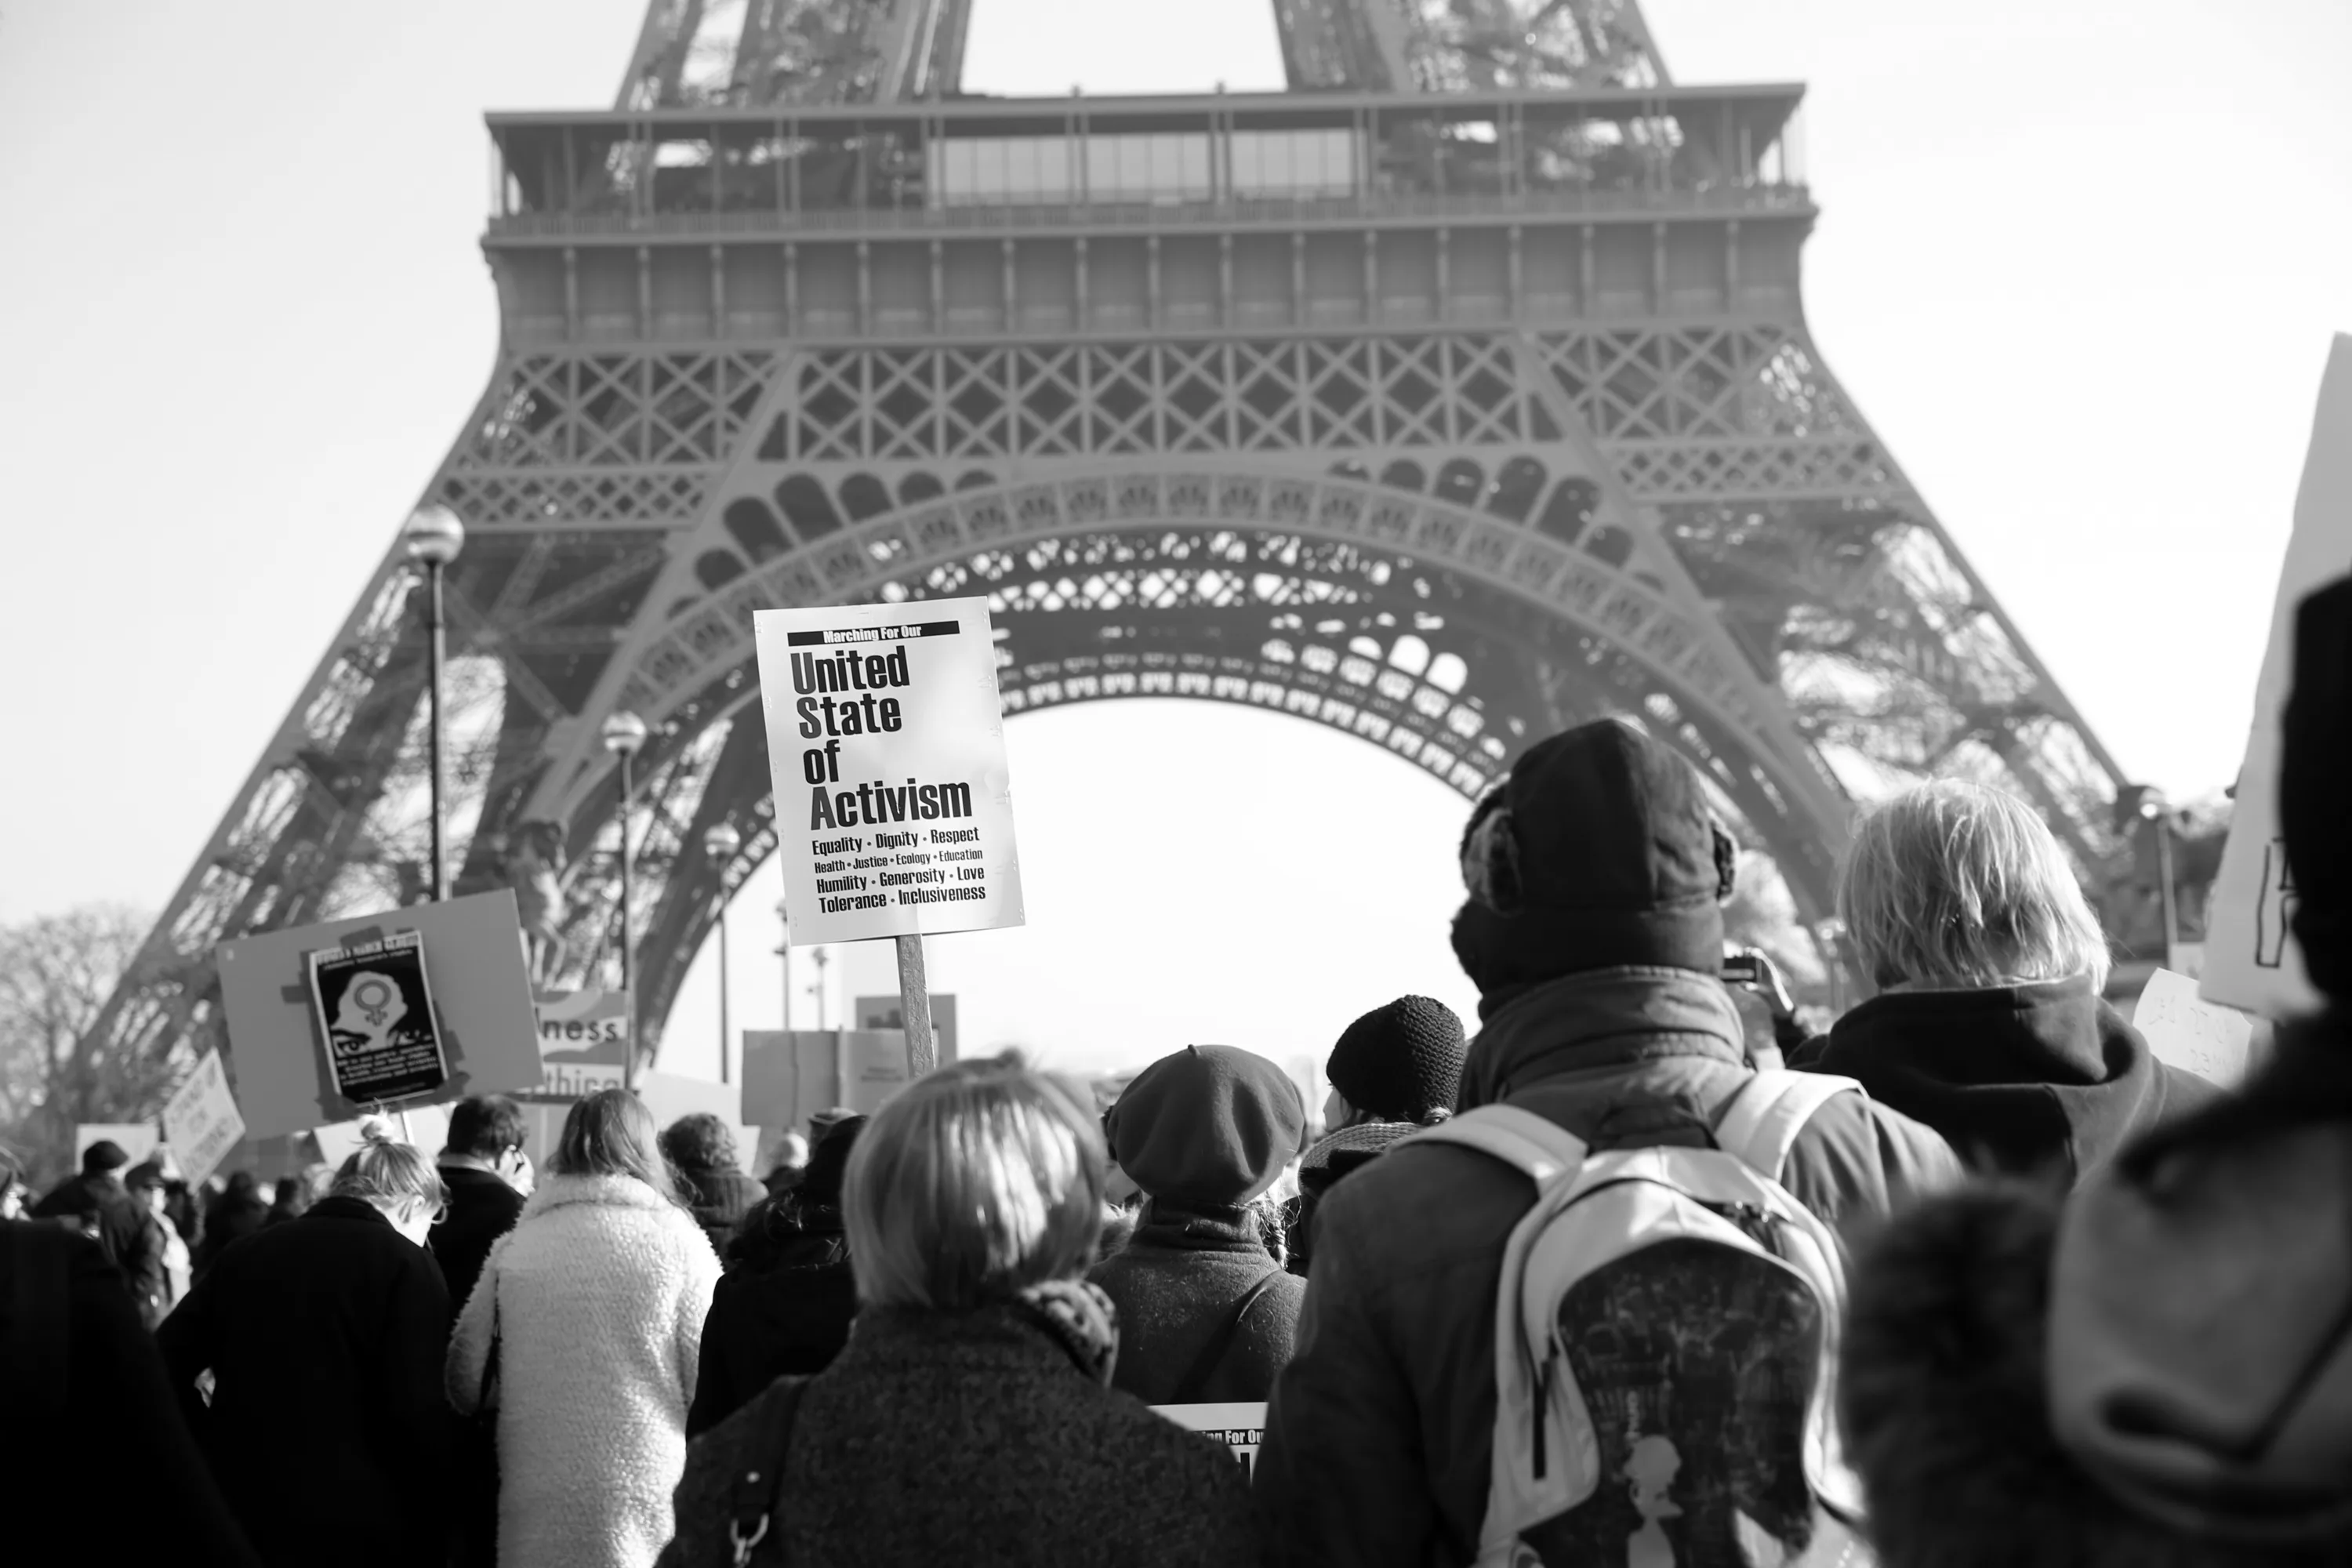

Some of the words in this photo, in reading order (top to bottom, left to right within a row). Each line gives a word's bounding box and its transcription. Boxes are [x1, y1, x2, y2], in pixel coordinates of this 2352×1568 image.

[823, 629, 879, 644] Marching
[880, 627, 899, 639] For
[901, 626, 921, 638] Our
[790, 646, 909, 694] United
[797, 694, 902, 739] State
[804, 740, 840, 784] of
[811, 779, 971, 830] Activism
[812, 837, 862, 856] Equality
[876, 832, 918, 849] Dignity
[931, 828, 979, 844] Respect
[815, 860, 845, 874] Health
[853, 856, 887, 869] Justice
[896, 852, 931, 866] Ecology
[939, 849, 983, 862] Education
[816, 875, 866, 893] Humility
[879, 869, 945, 887] Generosity
[957, 867, 984, 880] Love
[819, 894, 887, 913] Tolerance
[898, 886, 985, 906] Inclusiveness
[535, 1007, 617, 1042] ness
[1225, 1430, 1246, 1443] For
[1247, 1428, 1264, 1443] Ou
